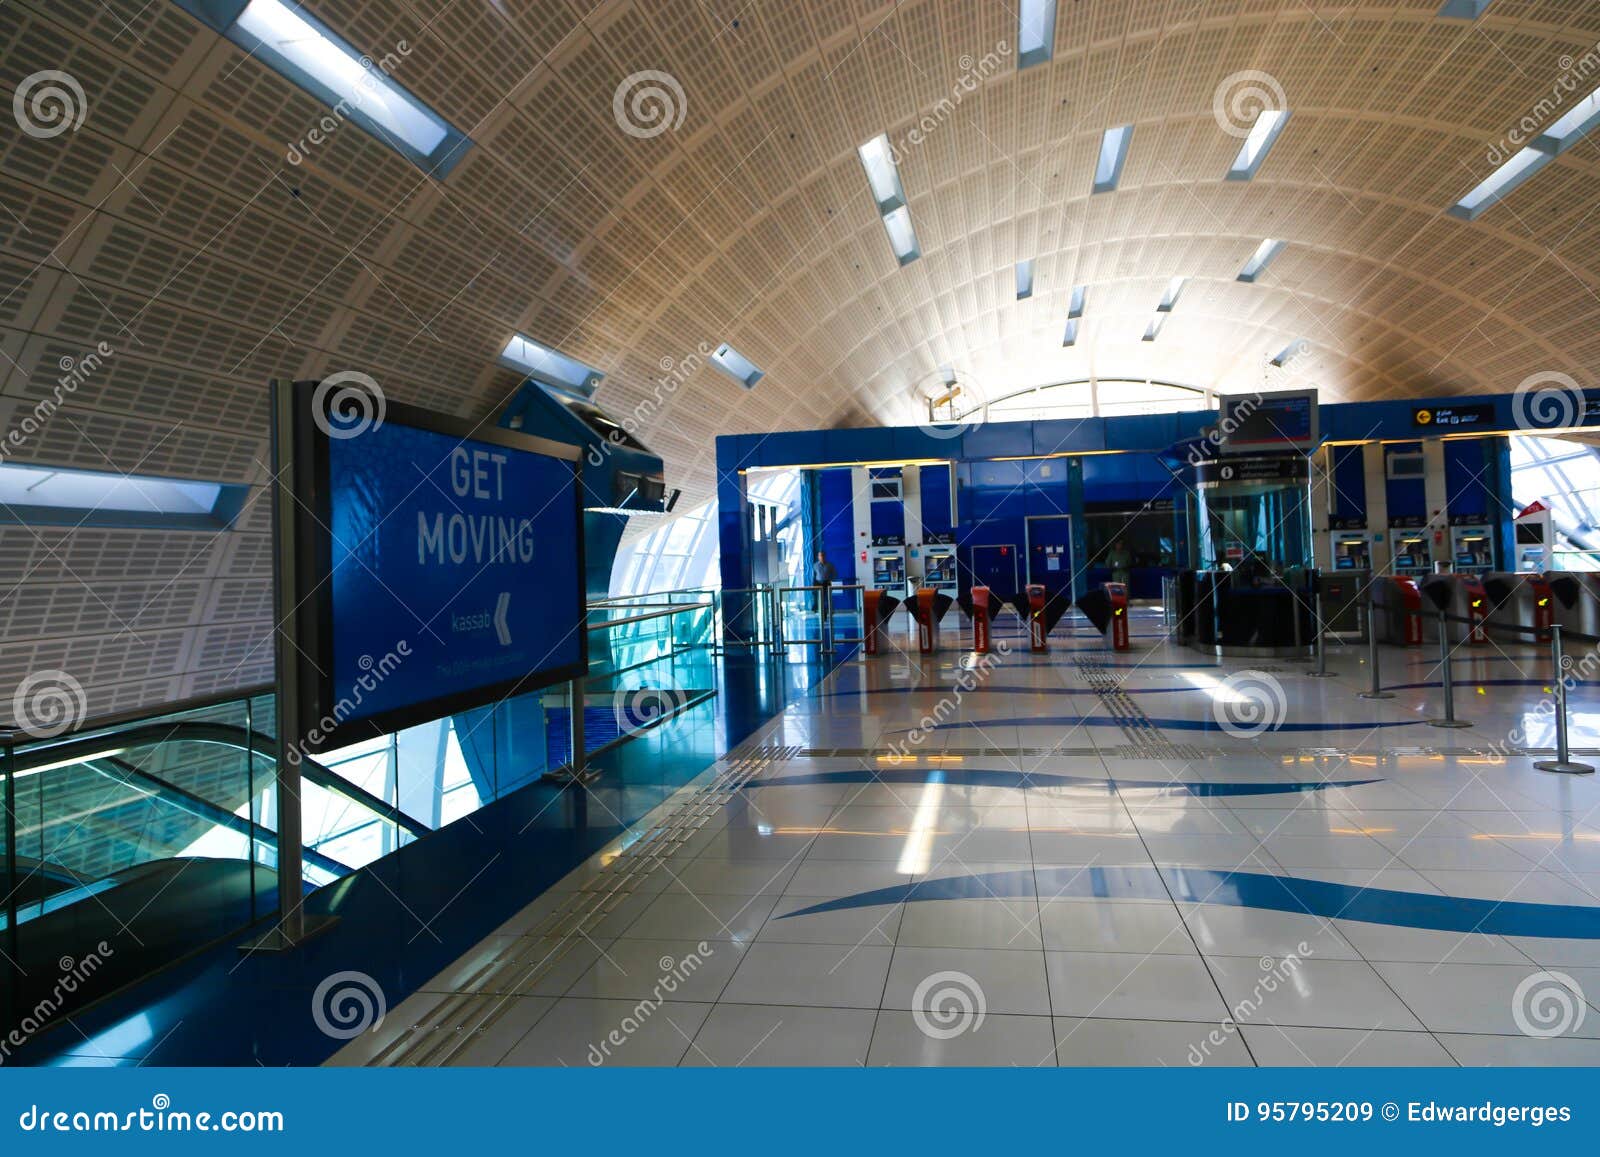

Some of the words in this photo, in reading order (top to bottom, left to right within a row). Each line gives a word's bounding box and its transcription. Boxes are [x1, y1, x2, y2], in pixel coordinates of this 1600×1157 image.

[450, 446, 508, 502] GET
[417, 510, 535, 566] MOVING
[451, 609, 491, 633] kassab
